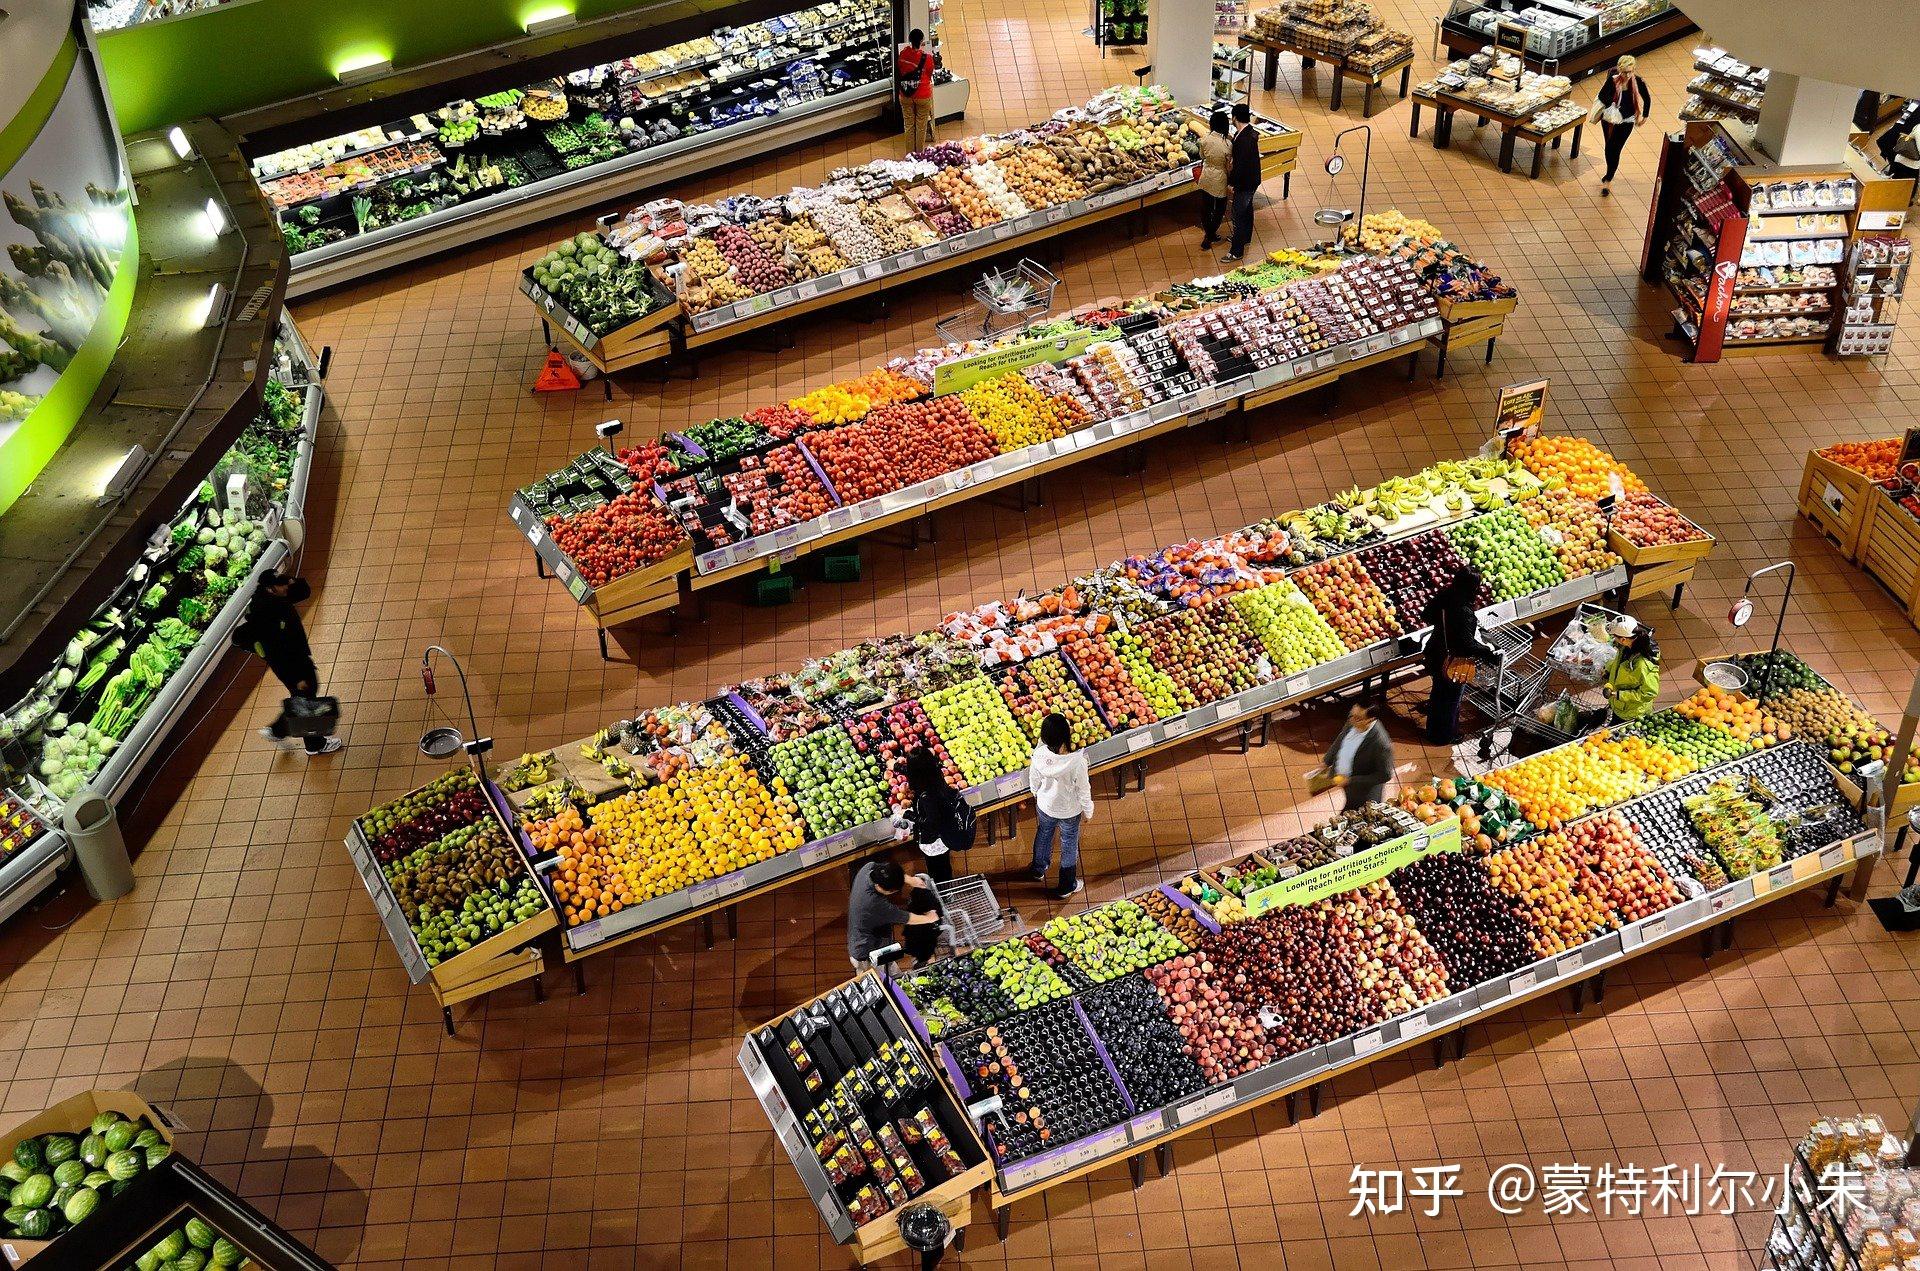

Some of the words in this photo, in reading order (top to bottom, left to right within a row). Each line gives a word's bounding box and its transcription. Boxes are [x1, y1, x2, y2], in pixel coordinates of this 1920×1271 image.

[963, 358, 986, 369] Looking
[987, 355, 997, 364] for
[997, 349, 1026, 361] nutritious
[1028, 342, 1053, 354] choices?
[978, 362, 997, 371] Reach
[998, 359, 1007, 367] for
[1008, 356, 1018, 364] the
[1019, 352, 1037, 362] Stars!
[1286, 877, 1317, 893] Looking
[1319, 871, 1331, 880] for
[1333, 856, 1372, 875] nutritious
[1374, 842, 1408, 859] choices?
[1308, 881, 1333, 893] Reach
[1334, 874, 1346, 884] for
[1348, 868, 1361, 879] the
[1363, 857, 1388, 873] Stars!
